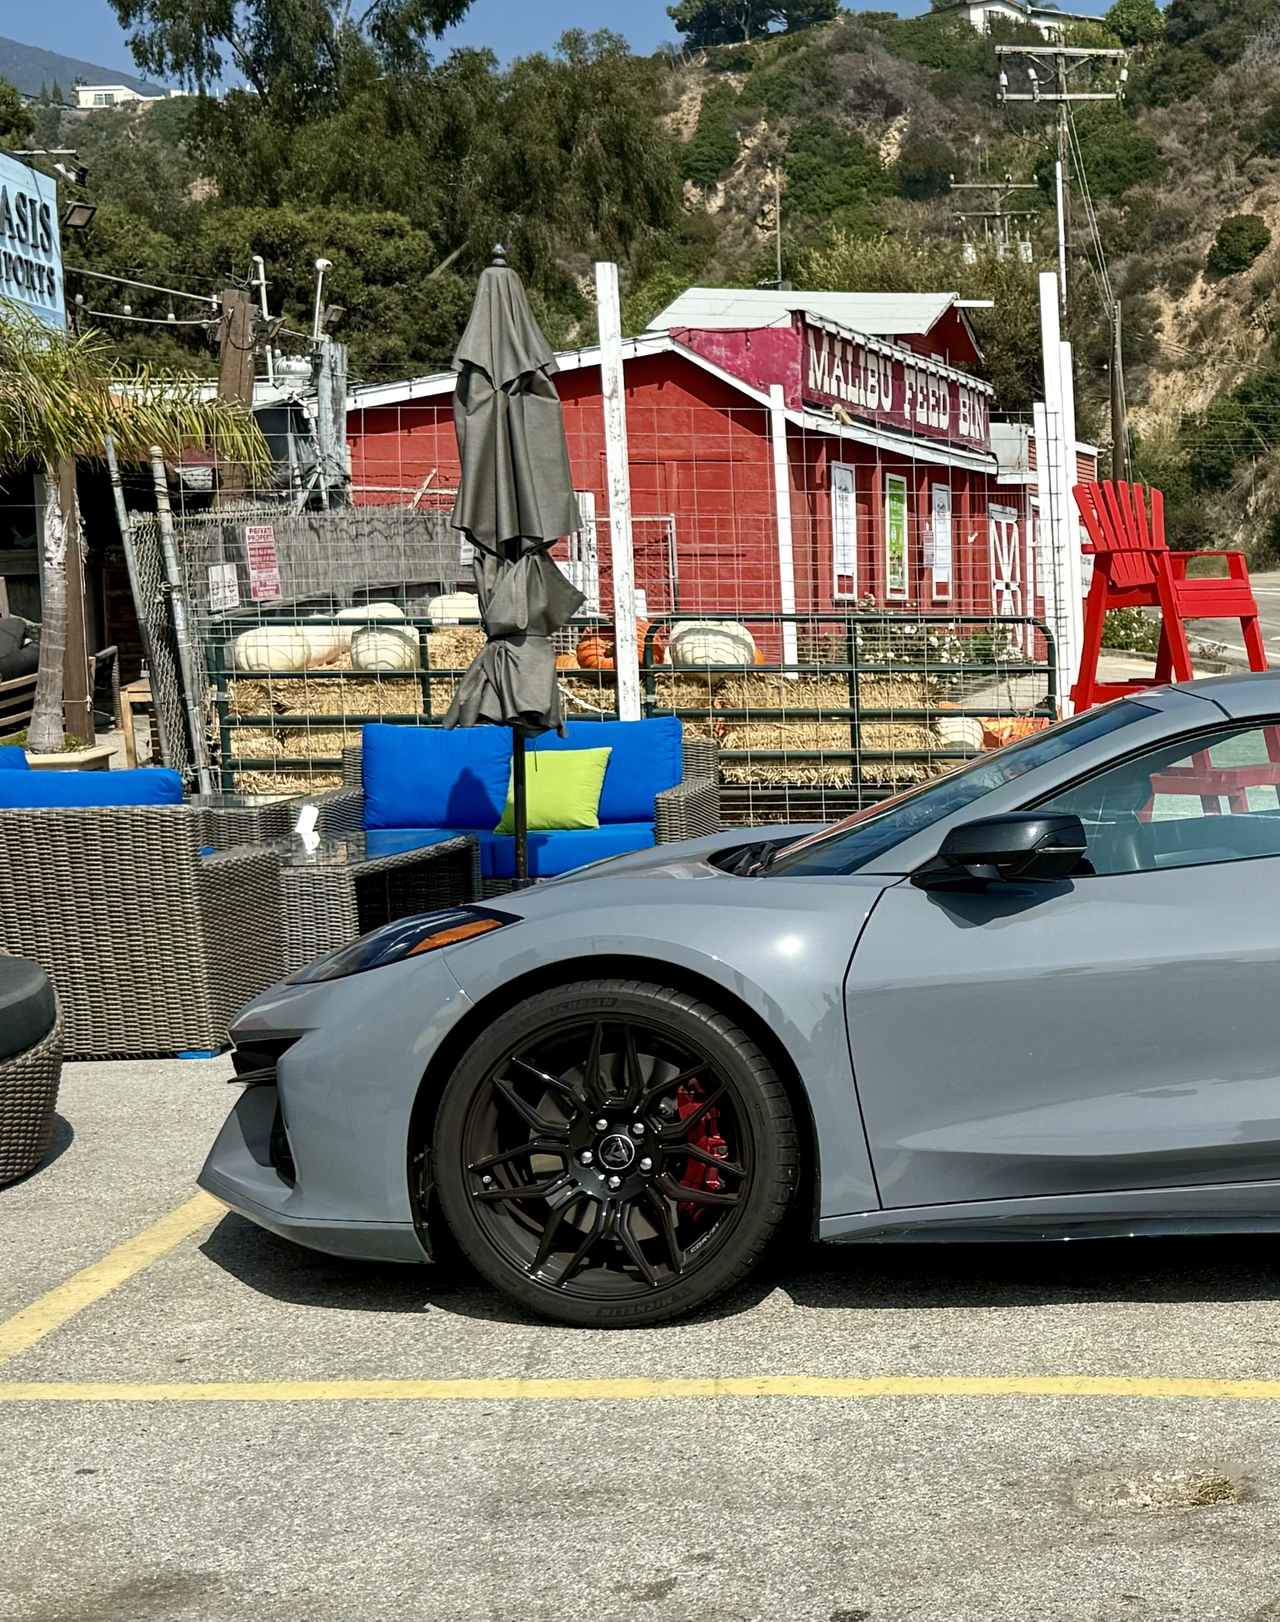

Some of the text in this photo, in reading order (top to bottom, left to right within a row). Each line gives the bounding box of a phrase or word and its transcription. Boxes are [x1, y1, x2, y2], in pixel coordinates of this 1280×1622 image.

[0, 251, 56, 297] PORTS
[807, 328, 986, 442] MALIBU FEED BIN
[601, 1296, 673, 1317] MICHELIN
